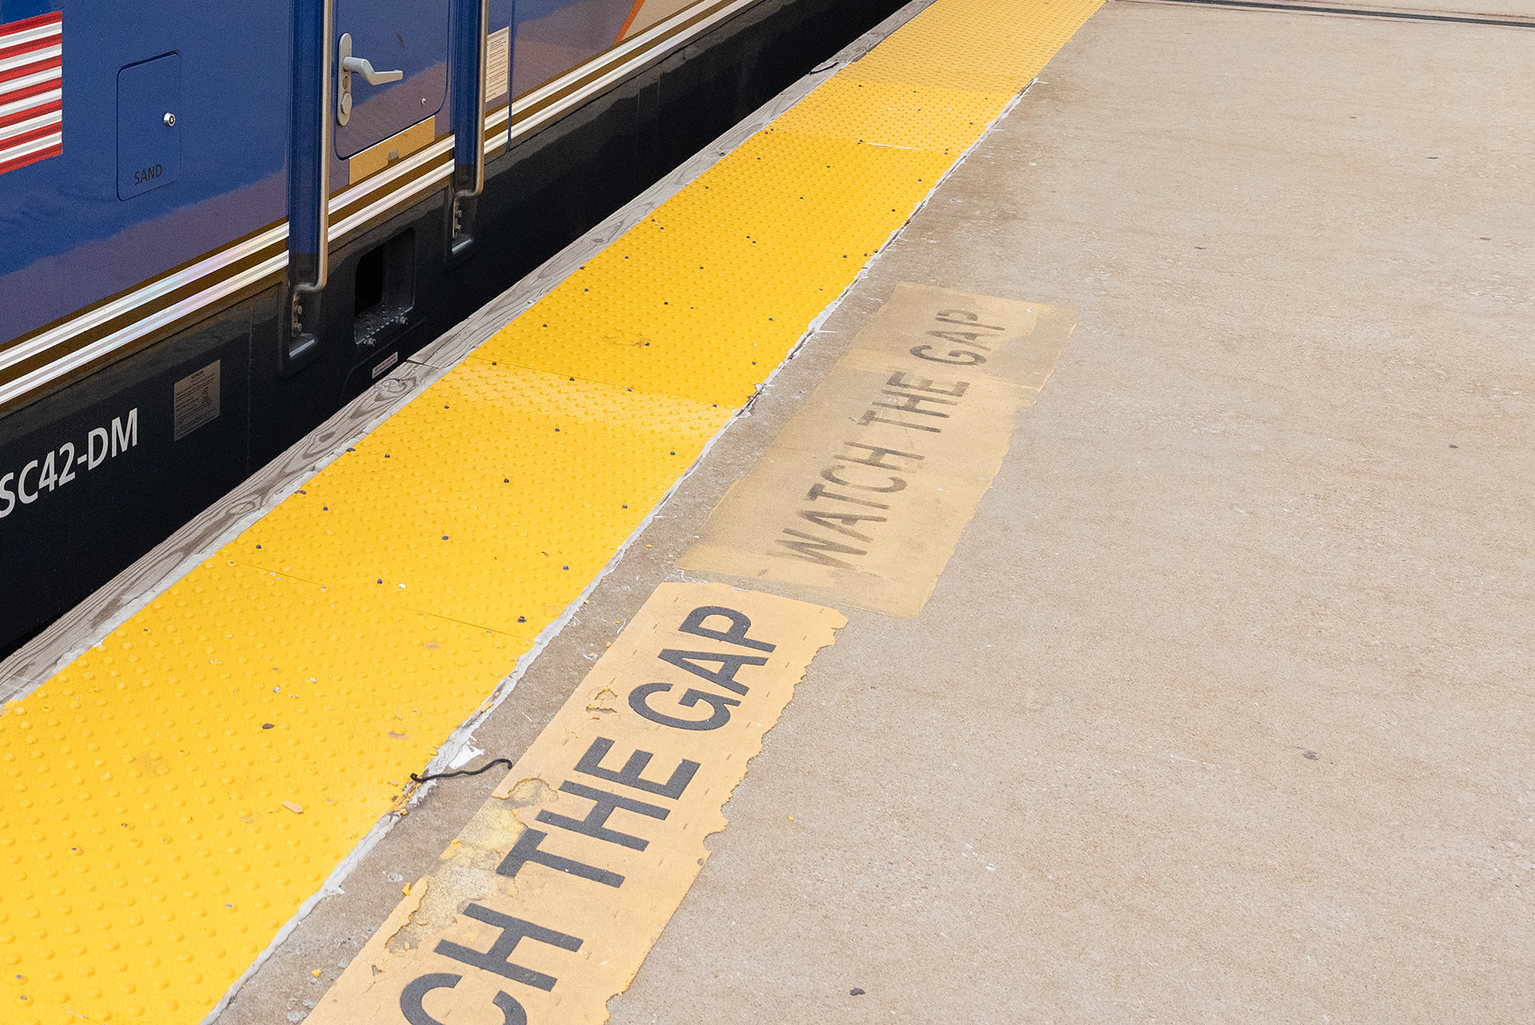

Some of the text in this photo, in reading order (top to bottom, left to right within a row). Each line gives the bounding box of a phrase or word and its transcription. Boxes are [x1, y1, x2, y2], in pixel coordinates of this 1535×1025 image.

[134, 163, 163, 186] SAND
[765, 308, 1006, 571] WATCH THE GAP
[496, 737, 701, 889] THE
[627, 605, 777, 732] GAP
